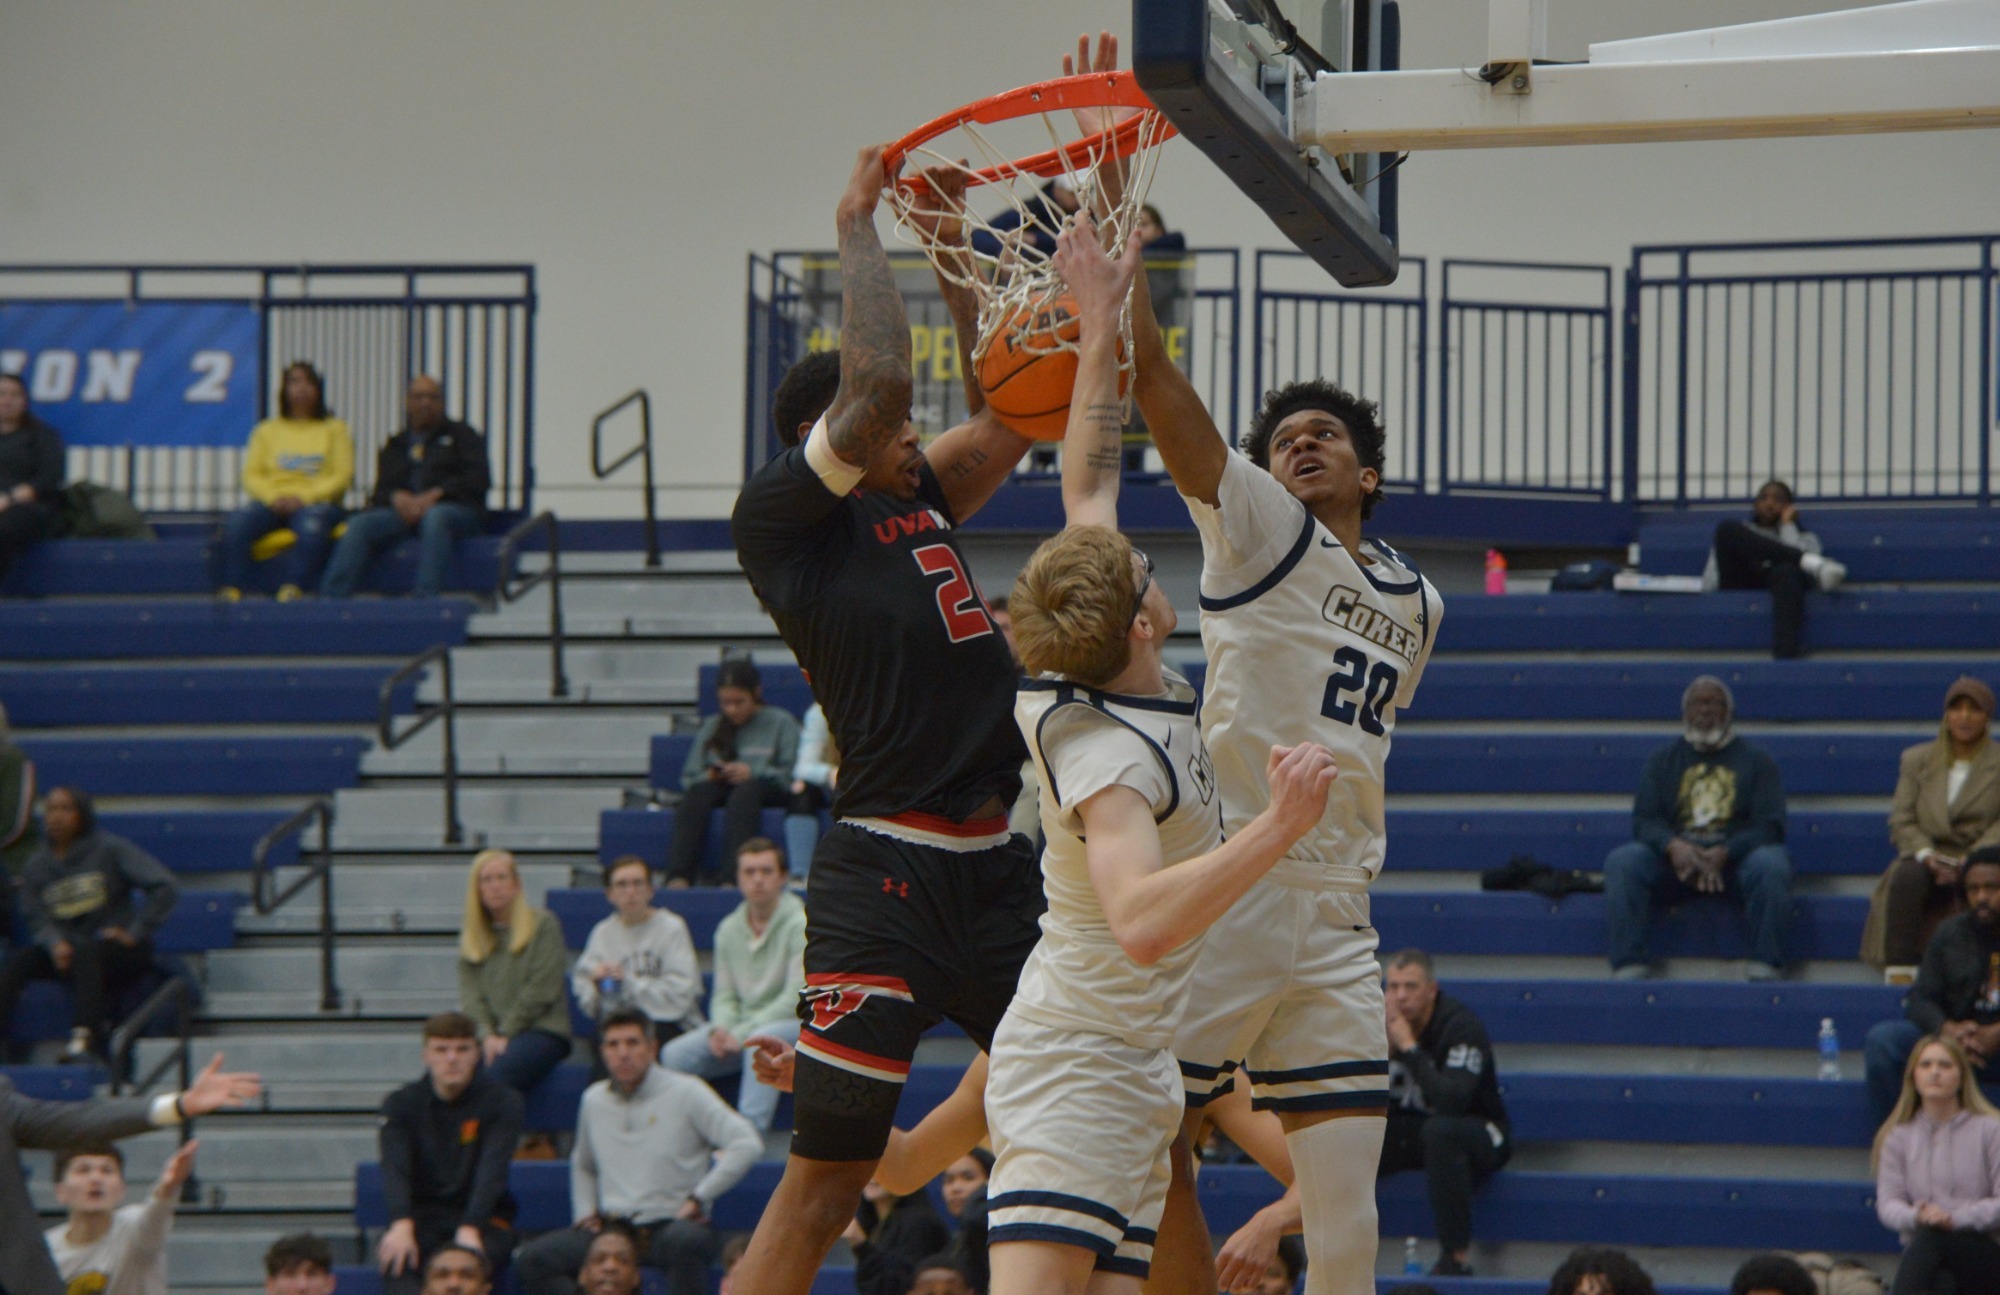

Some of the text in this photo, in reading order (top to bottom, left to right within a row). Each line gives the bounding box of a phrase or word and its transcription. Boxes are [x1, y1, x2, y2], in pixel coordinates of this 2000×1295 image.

[184, 349, 234, 402] 2
[911, 543, 995, 644] 2
[1322, 583, 1421, 667] COKER
[1320, 645, 1399, 738] 20
